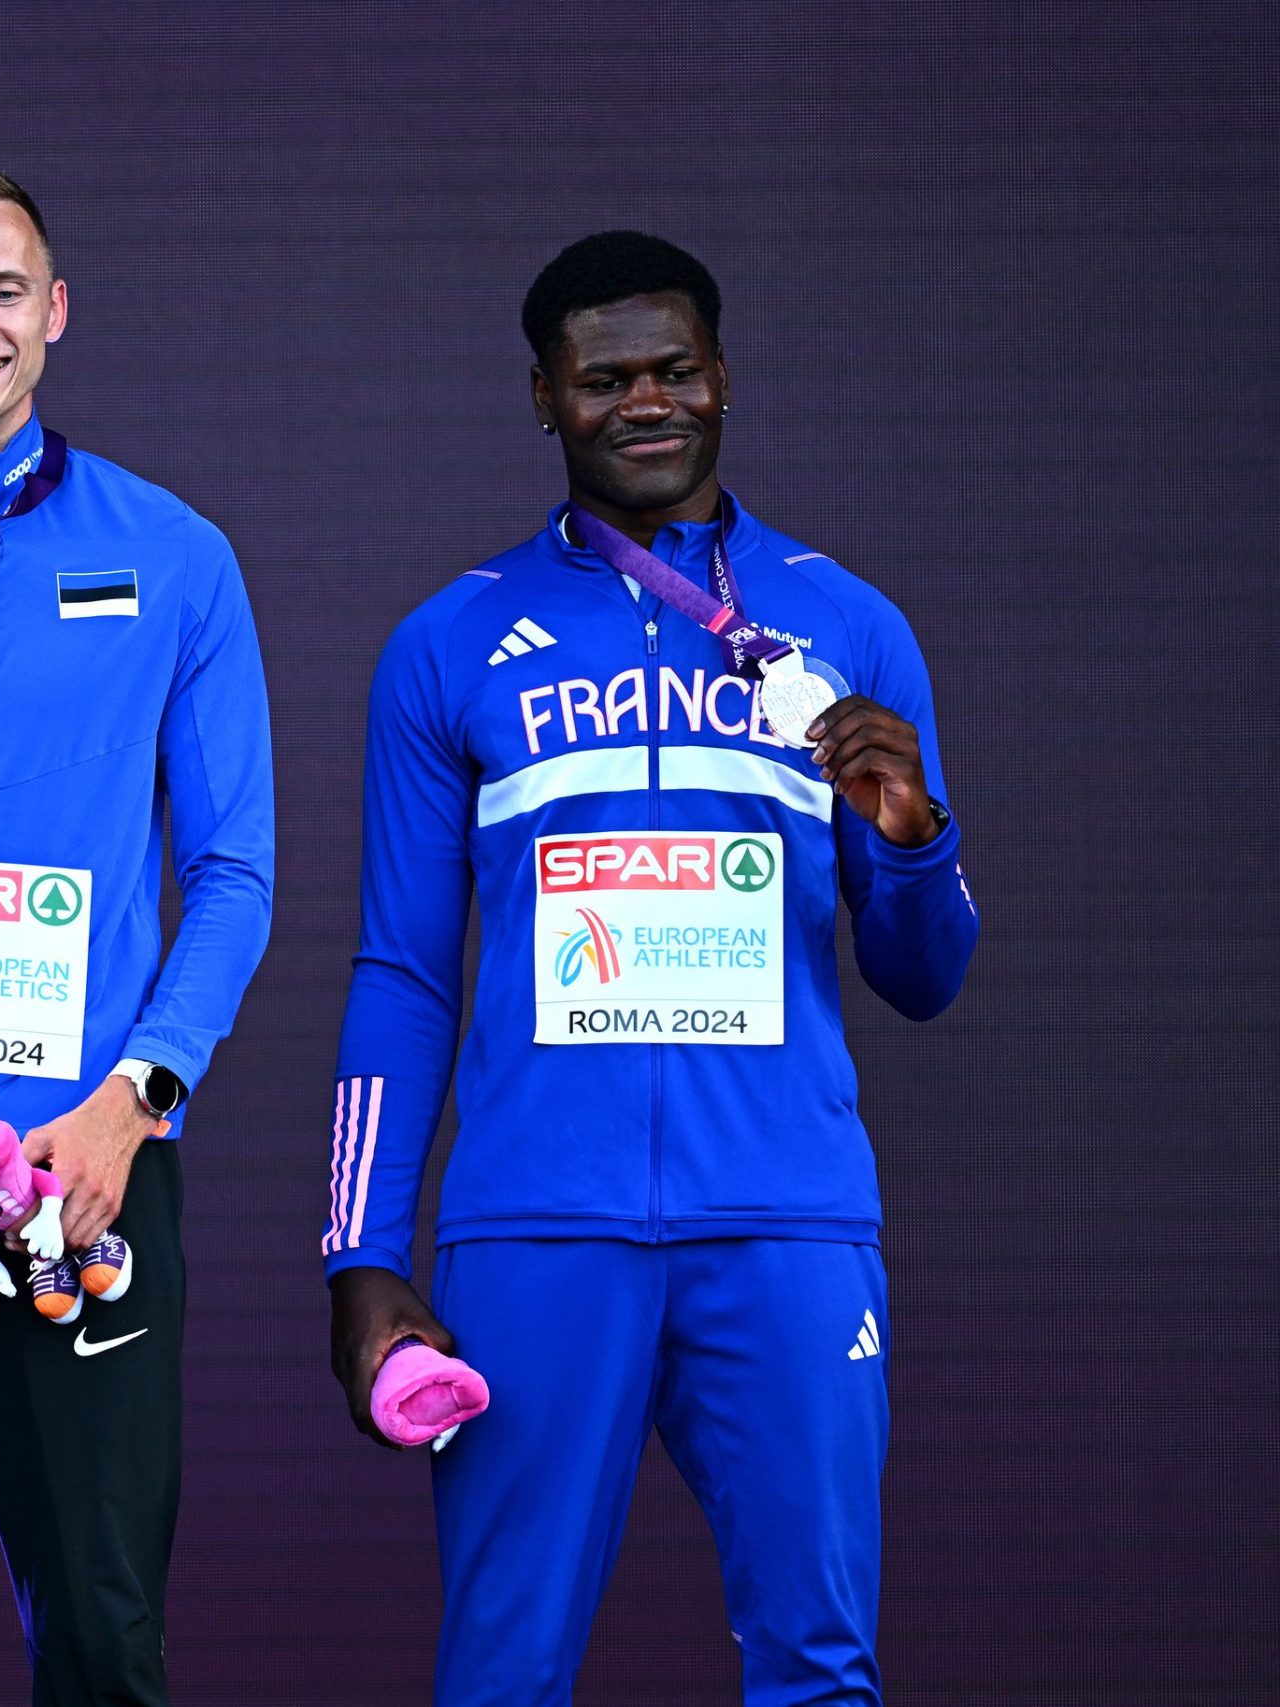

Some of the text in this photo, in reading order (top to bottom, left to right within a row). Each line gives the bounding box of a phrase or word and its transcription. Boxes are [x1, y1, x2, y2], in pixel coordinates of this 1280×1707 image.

[4, 458, 31, 486] coop
[763, 626, 813, 650] Mutuel
[544, 845, 710, 886] SPAR
[634, 927, 766, 946] EUROPEAN
[633, 949, 766, 968] ATHLETICS
[569, 1009, 747, 1034] ROMA 2024
